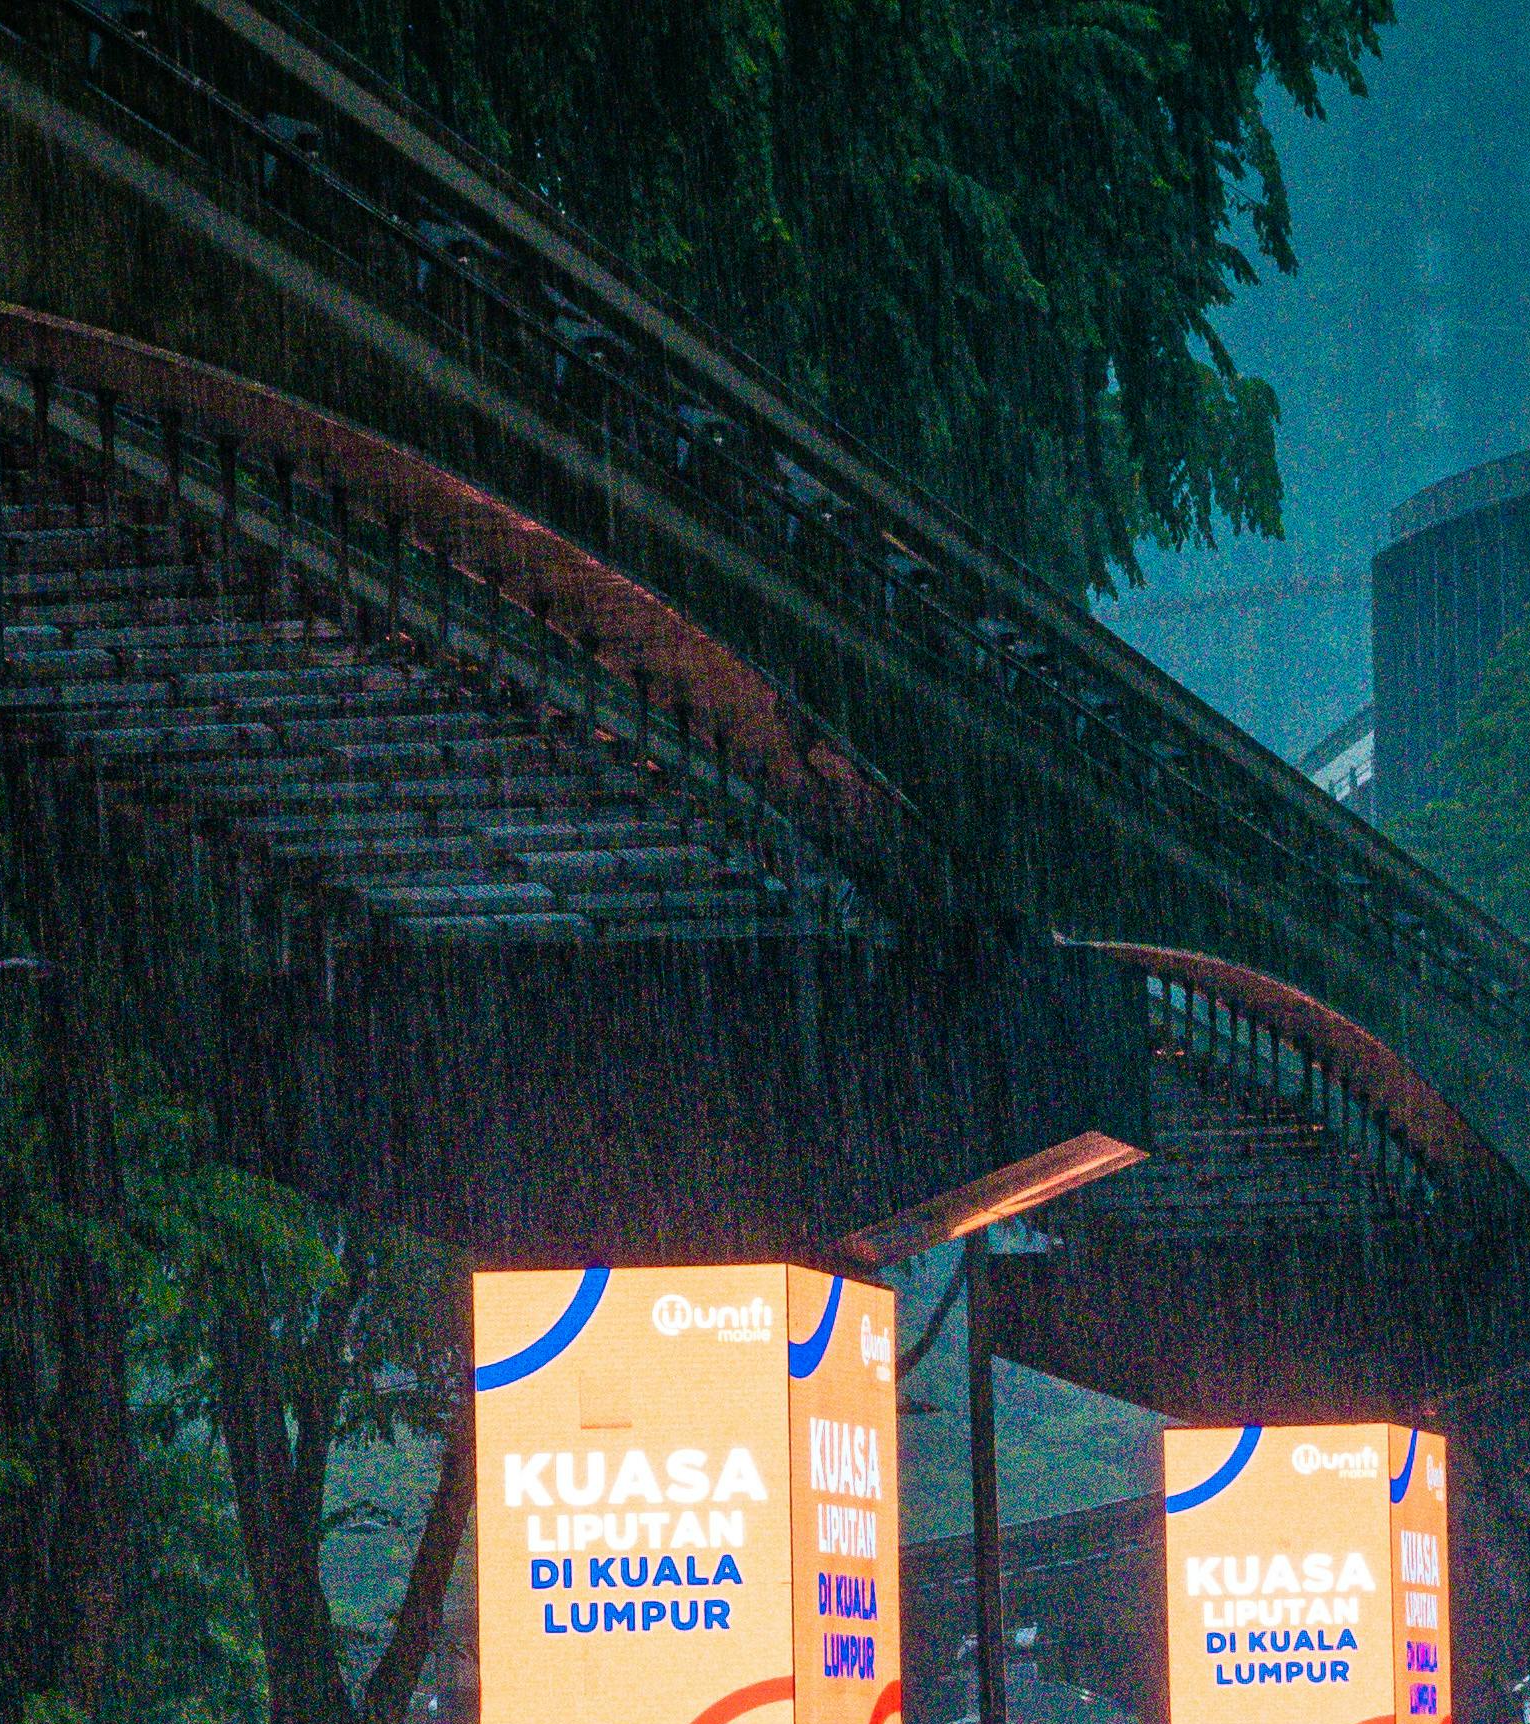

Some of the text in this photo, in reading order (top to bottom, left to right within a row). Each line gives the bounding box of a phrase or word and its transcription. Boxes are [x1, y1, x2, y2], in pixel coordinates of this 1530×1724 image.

[693, 1296, 773, 1329] unifi
[503, 1447, 769, 1507] KUASA
[809, 1416, 883, 1500] KUASA
[526, 1509, 746, 1553] LIPUTAN
[817, 1504, 878, 1560] LIPUTAN
[531, 1554, 743, 1590] DI KUALA
[1184, 1551, 1377, 1597] KUASA
[1400, 1530, 1441, 1587] KUASA
[544, 1599, 731, 1634] LUMPUR
[818, 1572, 878, 1621] DI KUALA
[1202, 1597, 1360, 1629] LIPUTAN
[824, 1633, 876, 1681] LUMPUR
[1206, 1628, 1358, 1654] DI KUALA
[1216, 1660, 1350, 1685] LUMPUR
